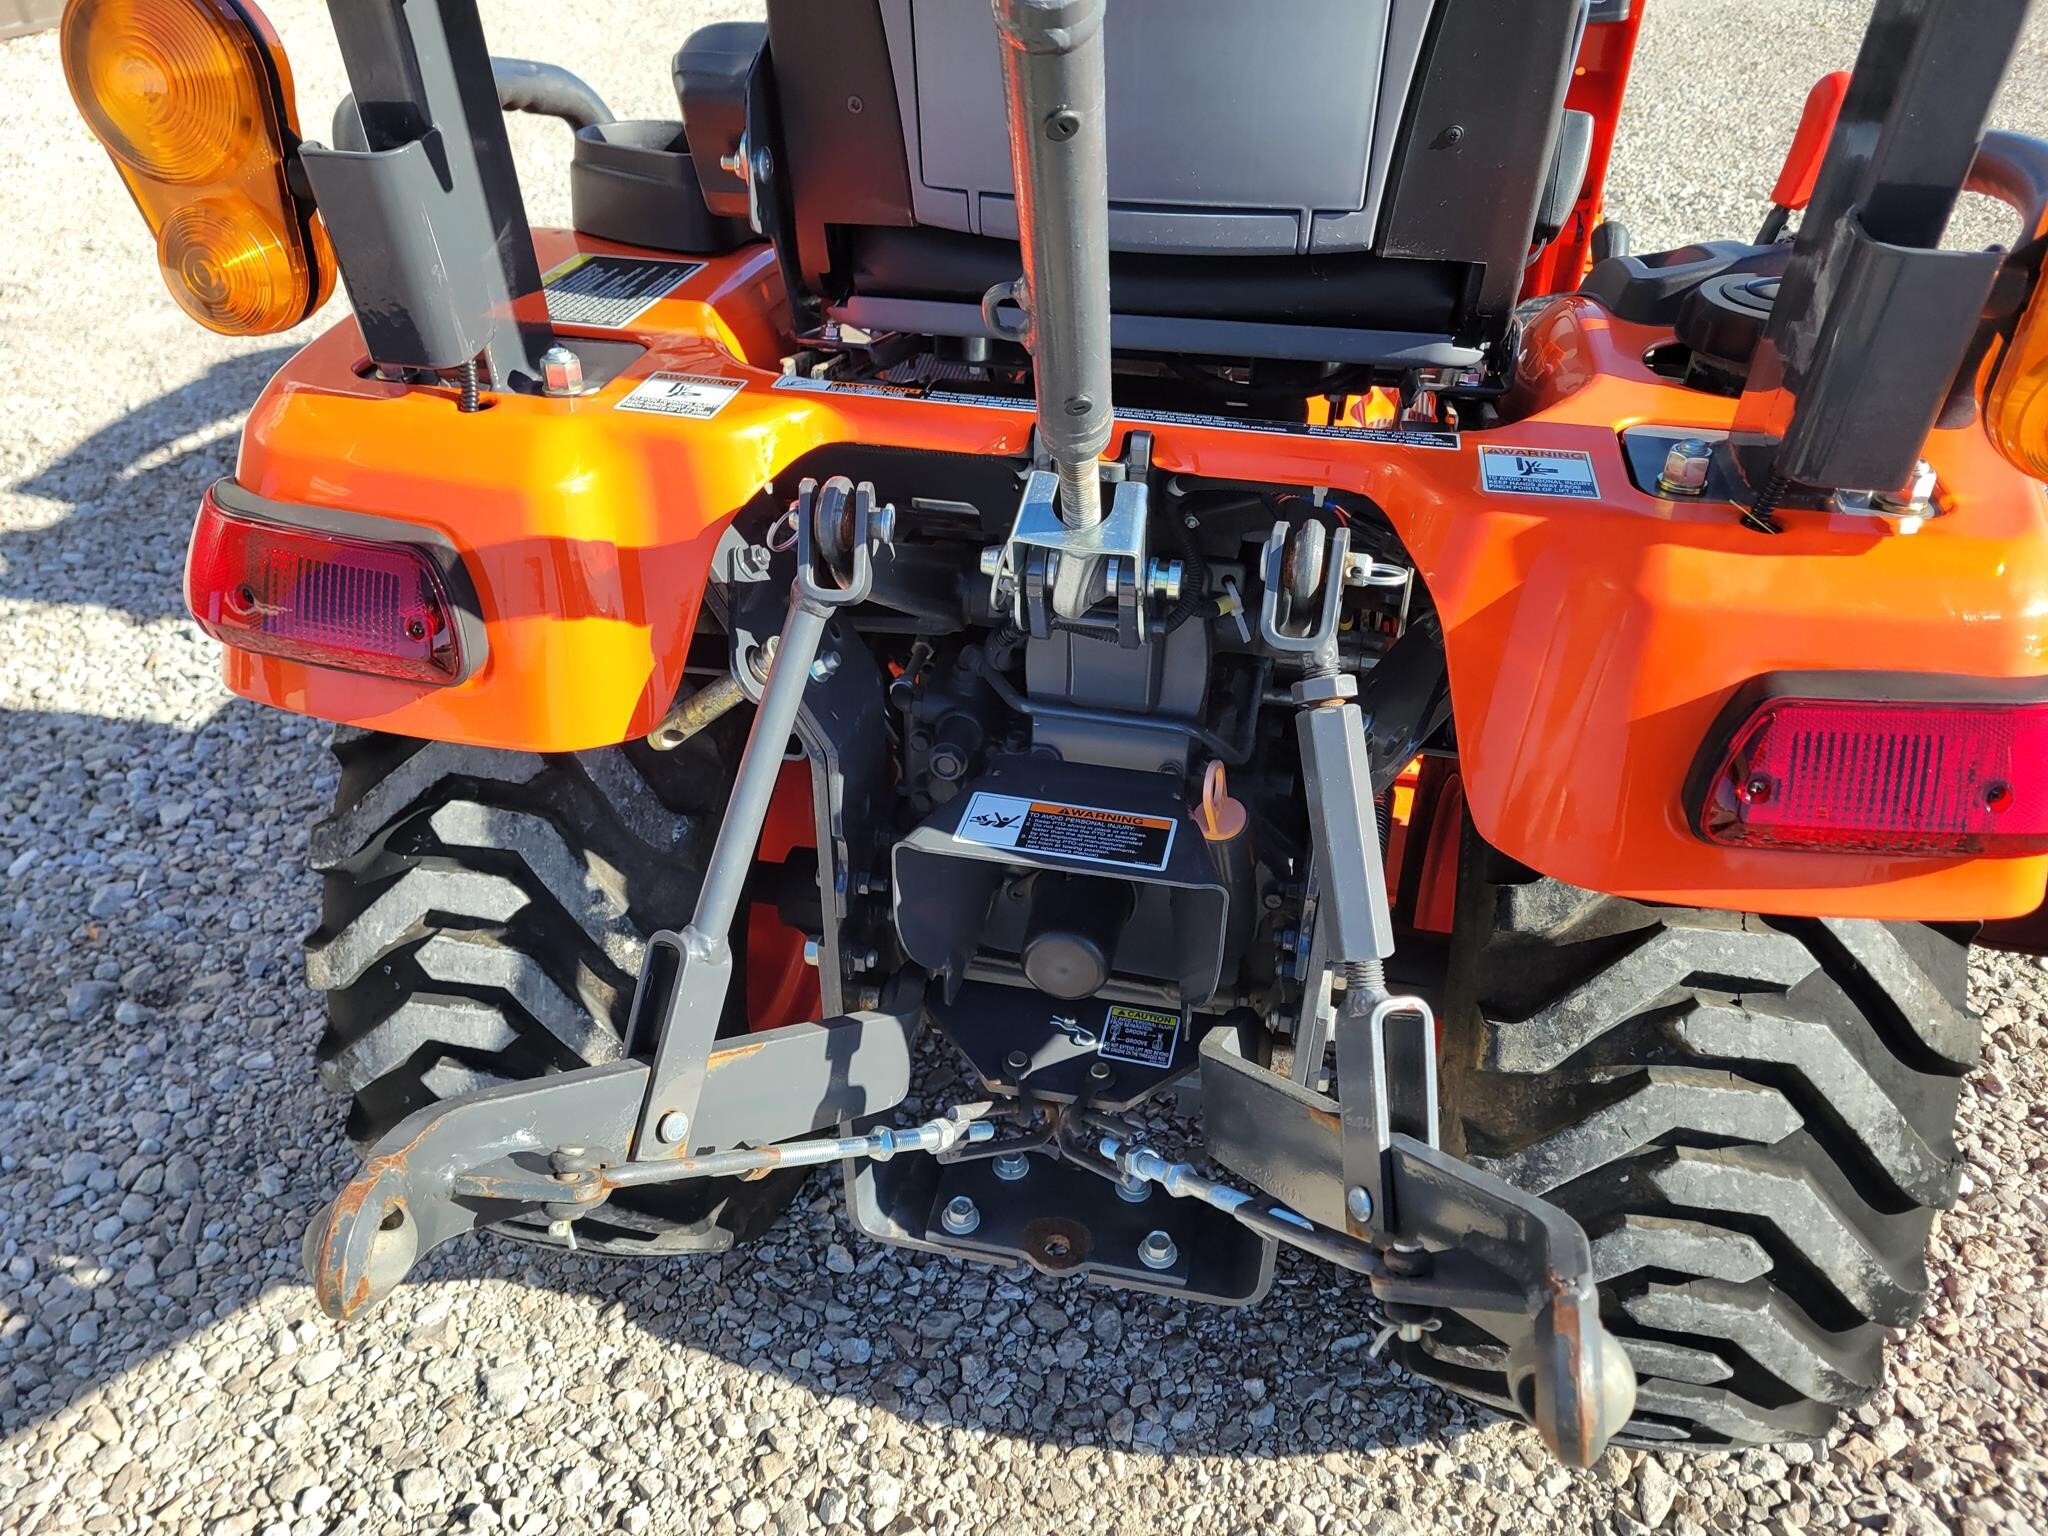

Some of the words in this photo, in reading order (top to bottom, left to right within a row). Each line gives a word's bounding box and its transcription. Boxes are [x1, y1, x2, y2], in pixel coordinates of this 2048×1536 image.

[1499, 448, 1584, 460] WARNING
[1064, 817, 1106, 827] PERSONAL
[1070, 809, 1144, 824] WARNING
[1127, 1011, 1170, 1023] CAUTION
[1124, 1027, 1147, 1036] GROOVE
[1124, 1037, 1148, 1046] GROOVE
